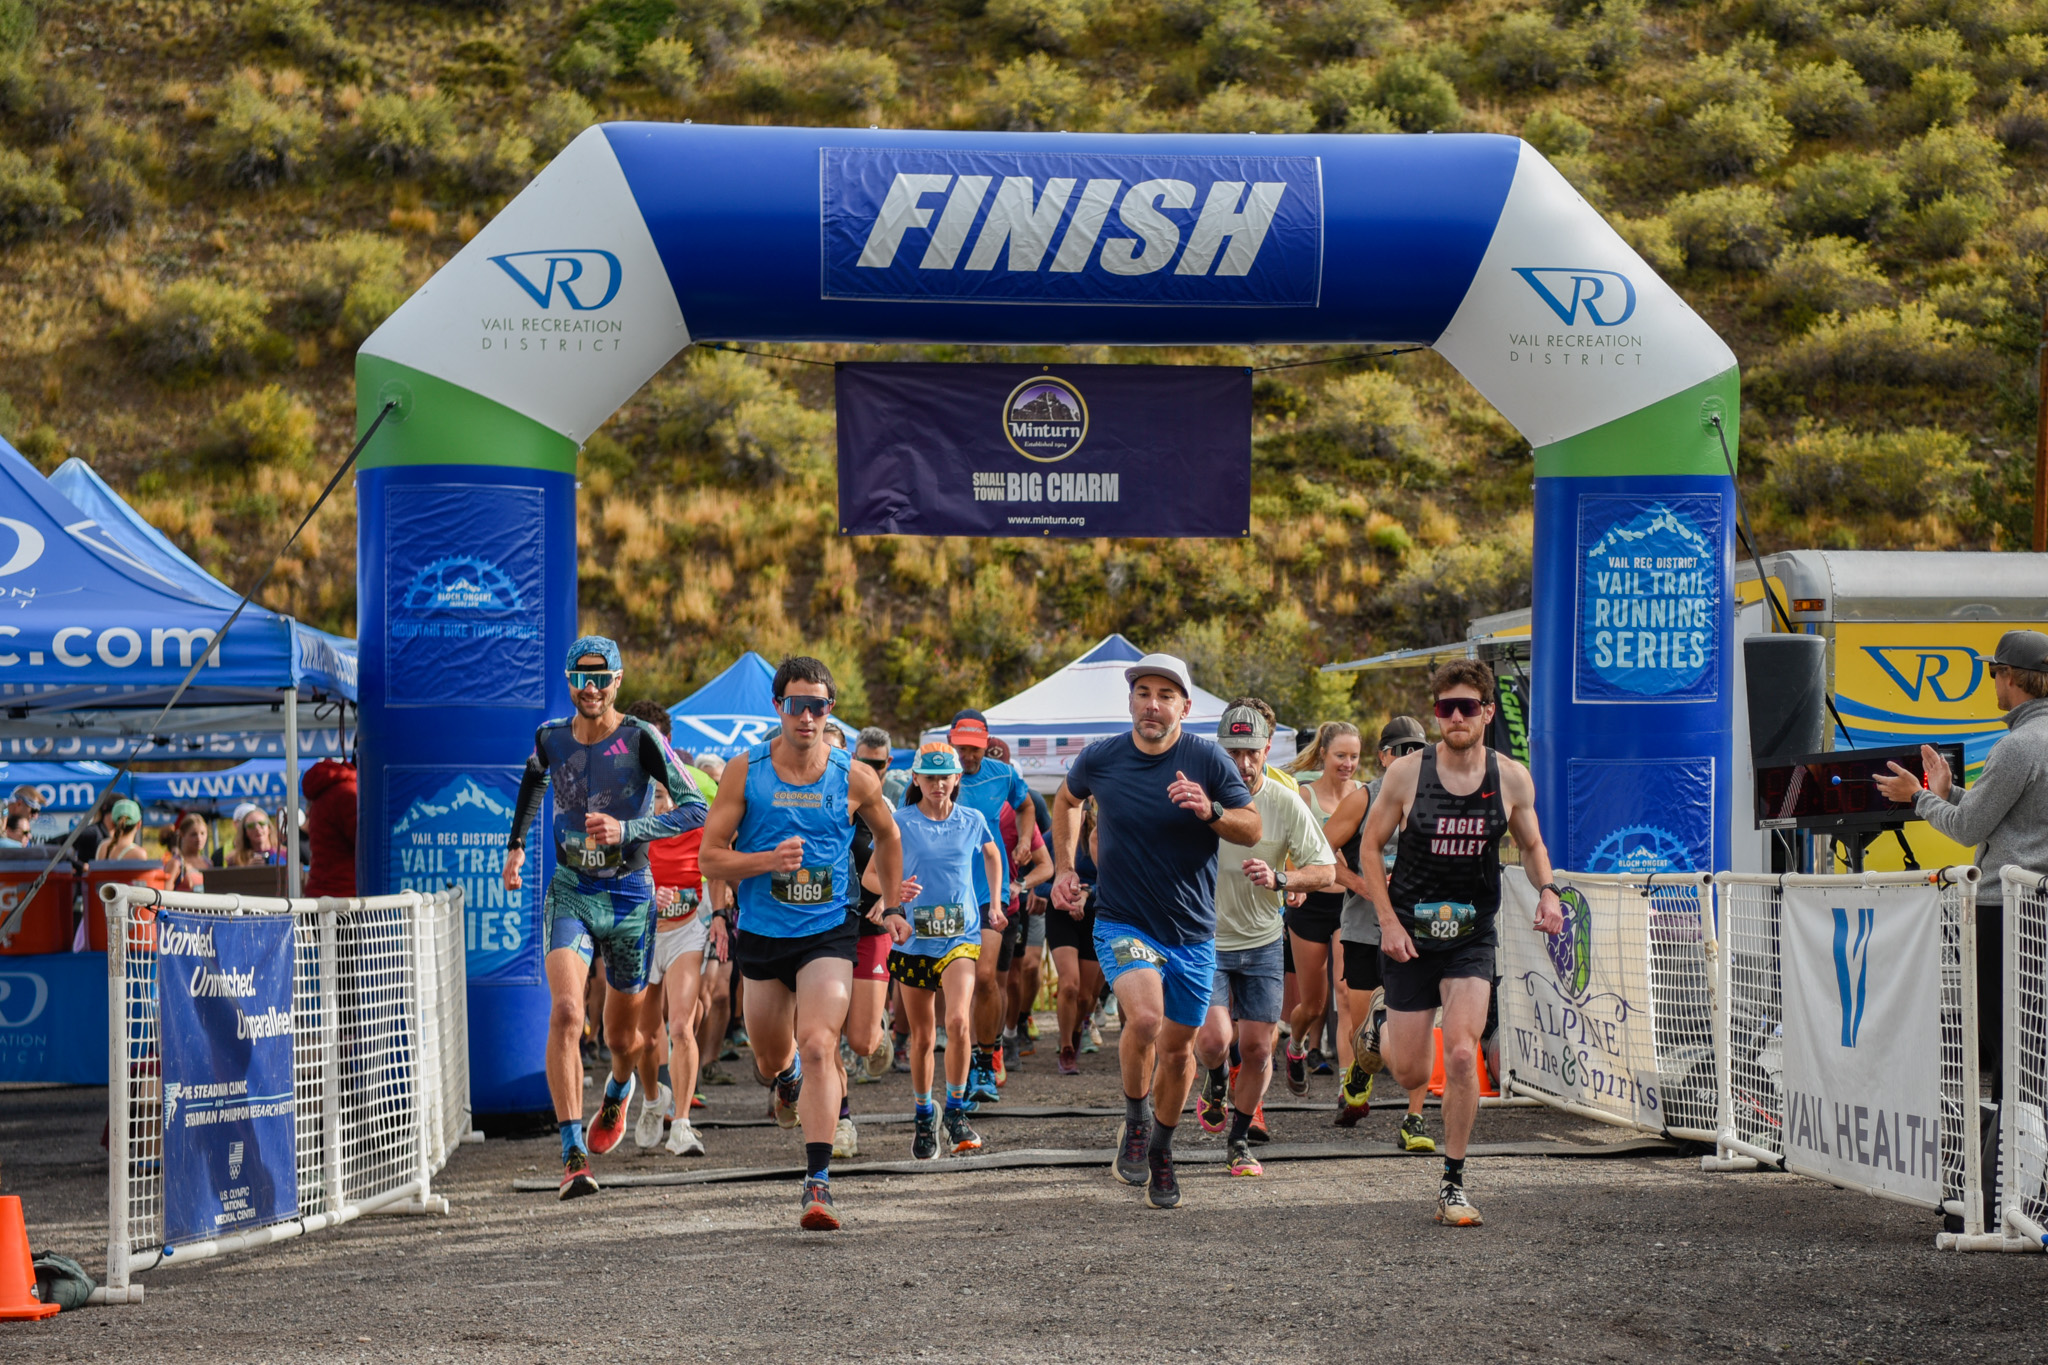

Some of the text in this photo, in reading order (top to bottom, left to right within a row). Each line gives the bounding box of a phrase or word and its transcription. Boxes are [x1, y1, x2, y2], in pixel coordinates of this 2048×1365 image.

[856, 172, 1288, 276] FINISH
[482, 318, 622, 333] VAIL RECREATION
[482, 337, 621, 351] DISTRICT
[1510, 333, 1642, 348] VAIL RECREATION
[1510, 350, 1642, 366] DISTRICT
[1008, 422, 1080, 438] Minturn
[972, 472, 1006, 487] SMALL
[1007, 472, 1119, 502] BIG CHARM
[973, 486, 1005, 501] TOWN
[1007, 515, 1086, 527] www.minturn.org
[1608, 556, 1698, 569] VAIL REC DISTRICT
[1597, 571, 1706, 595] VAIL TRAIL
[1595, 598, 1707, 628] RUNNING
[392, 623, 441, 638] MOUNTAIN
[444, 623, 468, 638] BIKE
[472, 623, 502, 639] TOWN
[1594, 631, 1706, 669] SERIES
[774, 791, 822, 801] COLORADO
[1437, 817, 1485, 835] EAGLE
[411, 832, 433, 846] VAIL
[437, 832, 458, 846] REC
[1430, 838, 1487, 857] VALLEY
[401, 849, 448, 873] VAIL
[579, 849, 606, 867] 750
[785, 883, 822, 902] 1969
[925, 918, 956, 936] 1913
[1430, 920, 1460, 938] 828
[1533, 999, 1620, 1057] ALPINE
[1515, 1026, 1659, 1111] Wine & Spirits
[229, 1080, 248, 1096] CLINIC
[250, 1101, 279, 1119] RESEARCH
[1786, 1088, 1830, 1155] VAIL
[1834, 1101, 1939, 1182] HEALTH
[236, 1208, 256, 1222] CENTER
